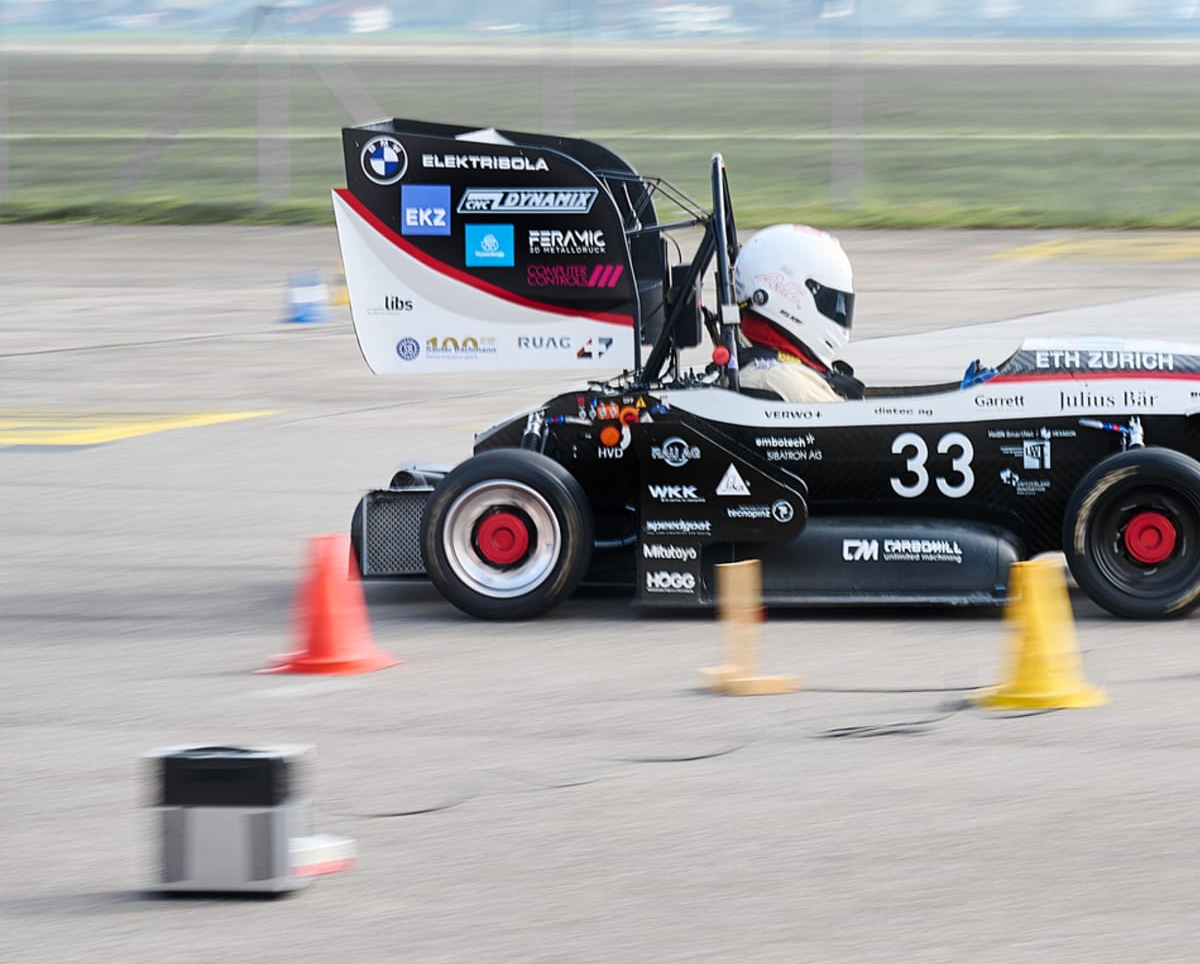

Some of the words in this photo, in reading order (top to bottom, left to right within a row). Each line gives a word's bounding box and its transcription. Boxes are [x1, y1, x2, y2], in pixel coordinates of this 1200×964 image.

[504, 192, 592, 207] DYNAMIX
[405, 207, 447, 226] EKZ
[528, 230, 606, 247] FERAMIC
[385, 295, 414, 312] libs
[518, 337, 571, 349] RUAG
[1036, 351, 1080, 369] ETH
[974, 394, 1025, 408] Garrett
[1059, 391, 1116, 411] Julius
[1123, 390, 1158, 407] Bär
[755, 435, 806, 447] embotech
[598, 447, 624, 458] HVD
[890, 432, 975, 498] 33
[648, 485, 698, 499] WKK
[643, 543, 697, 562] Mitutoyo
